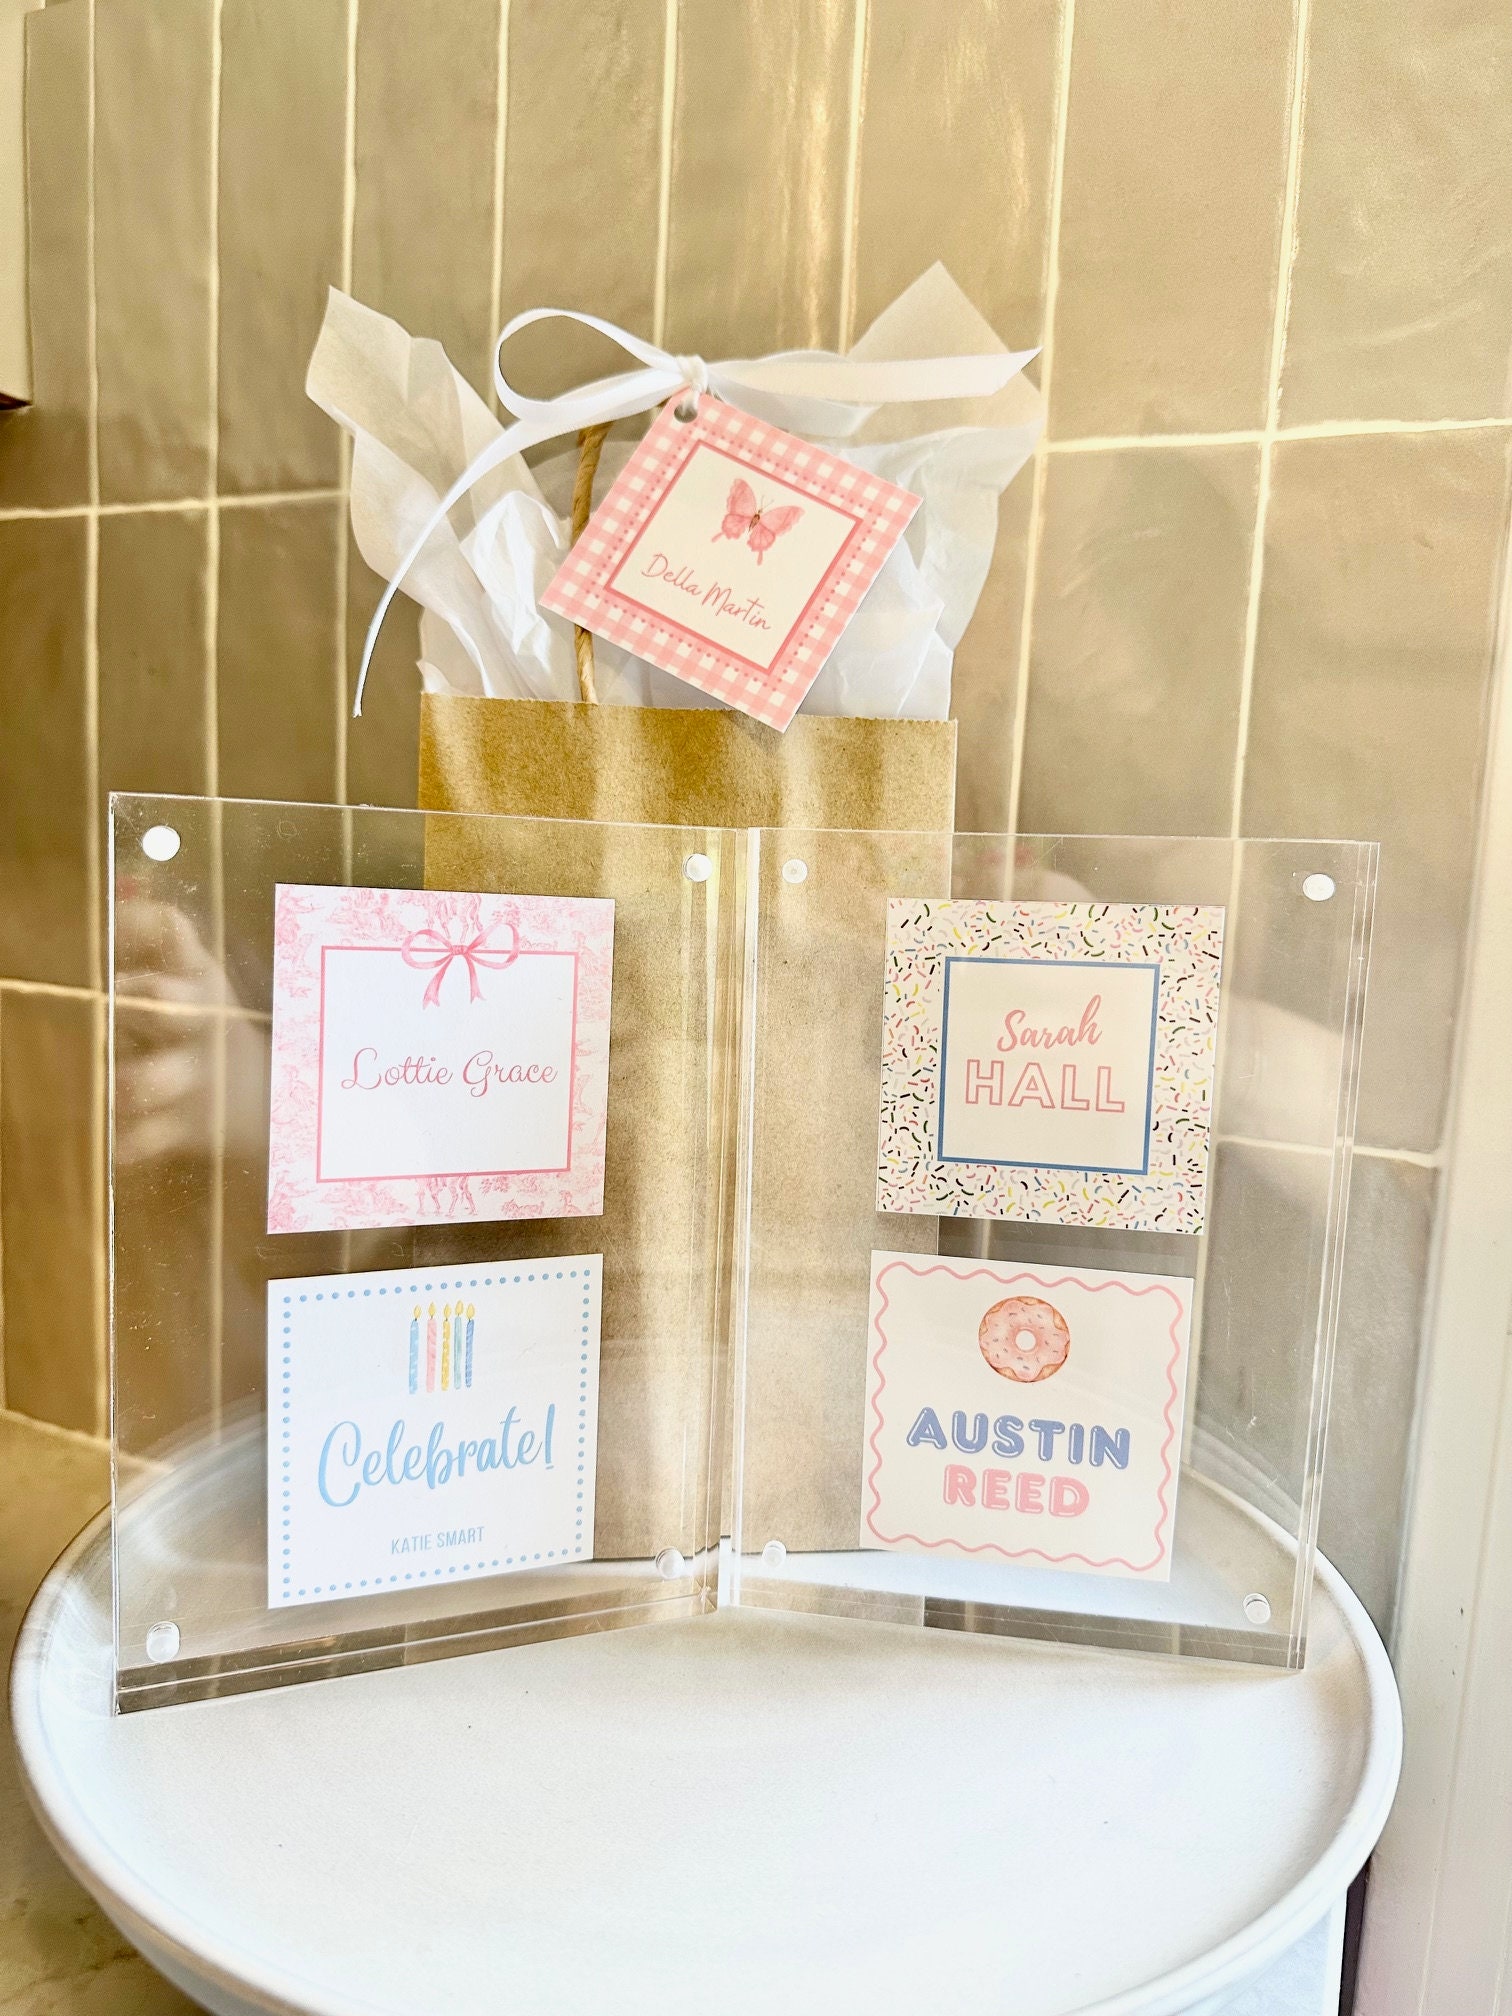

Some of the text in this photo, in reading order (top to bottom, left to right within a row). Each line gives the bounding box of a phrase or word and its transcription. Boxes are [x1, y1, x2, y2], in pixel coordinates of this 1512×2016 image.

[641, 552, 771, 631] Della Martin
[997, 994, 1102, 1052] Sarah
[341, 1047, 558, 1098] Lottie Grace
[965, 1058, 1125, 1113] HALL
[318, 1403, 556, 1507] Celebrate!
[906, 1406, 1131, 1470] AUSTIN
[943, 1463, 1090, 1518] REED
[391, 1526, 485, 1555] KATIE SMART
